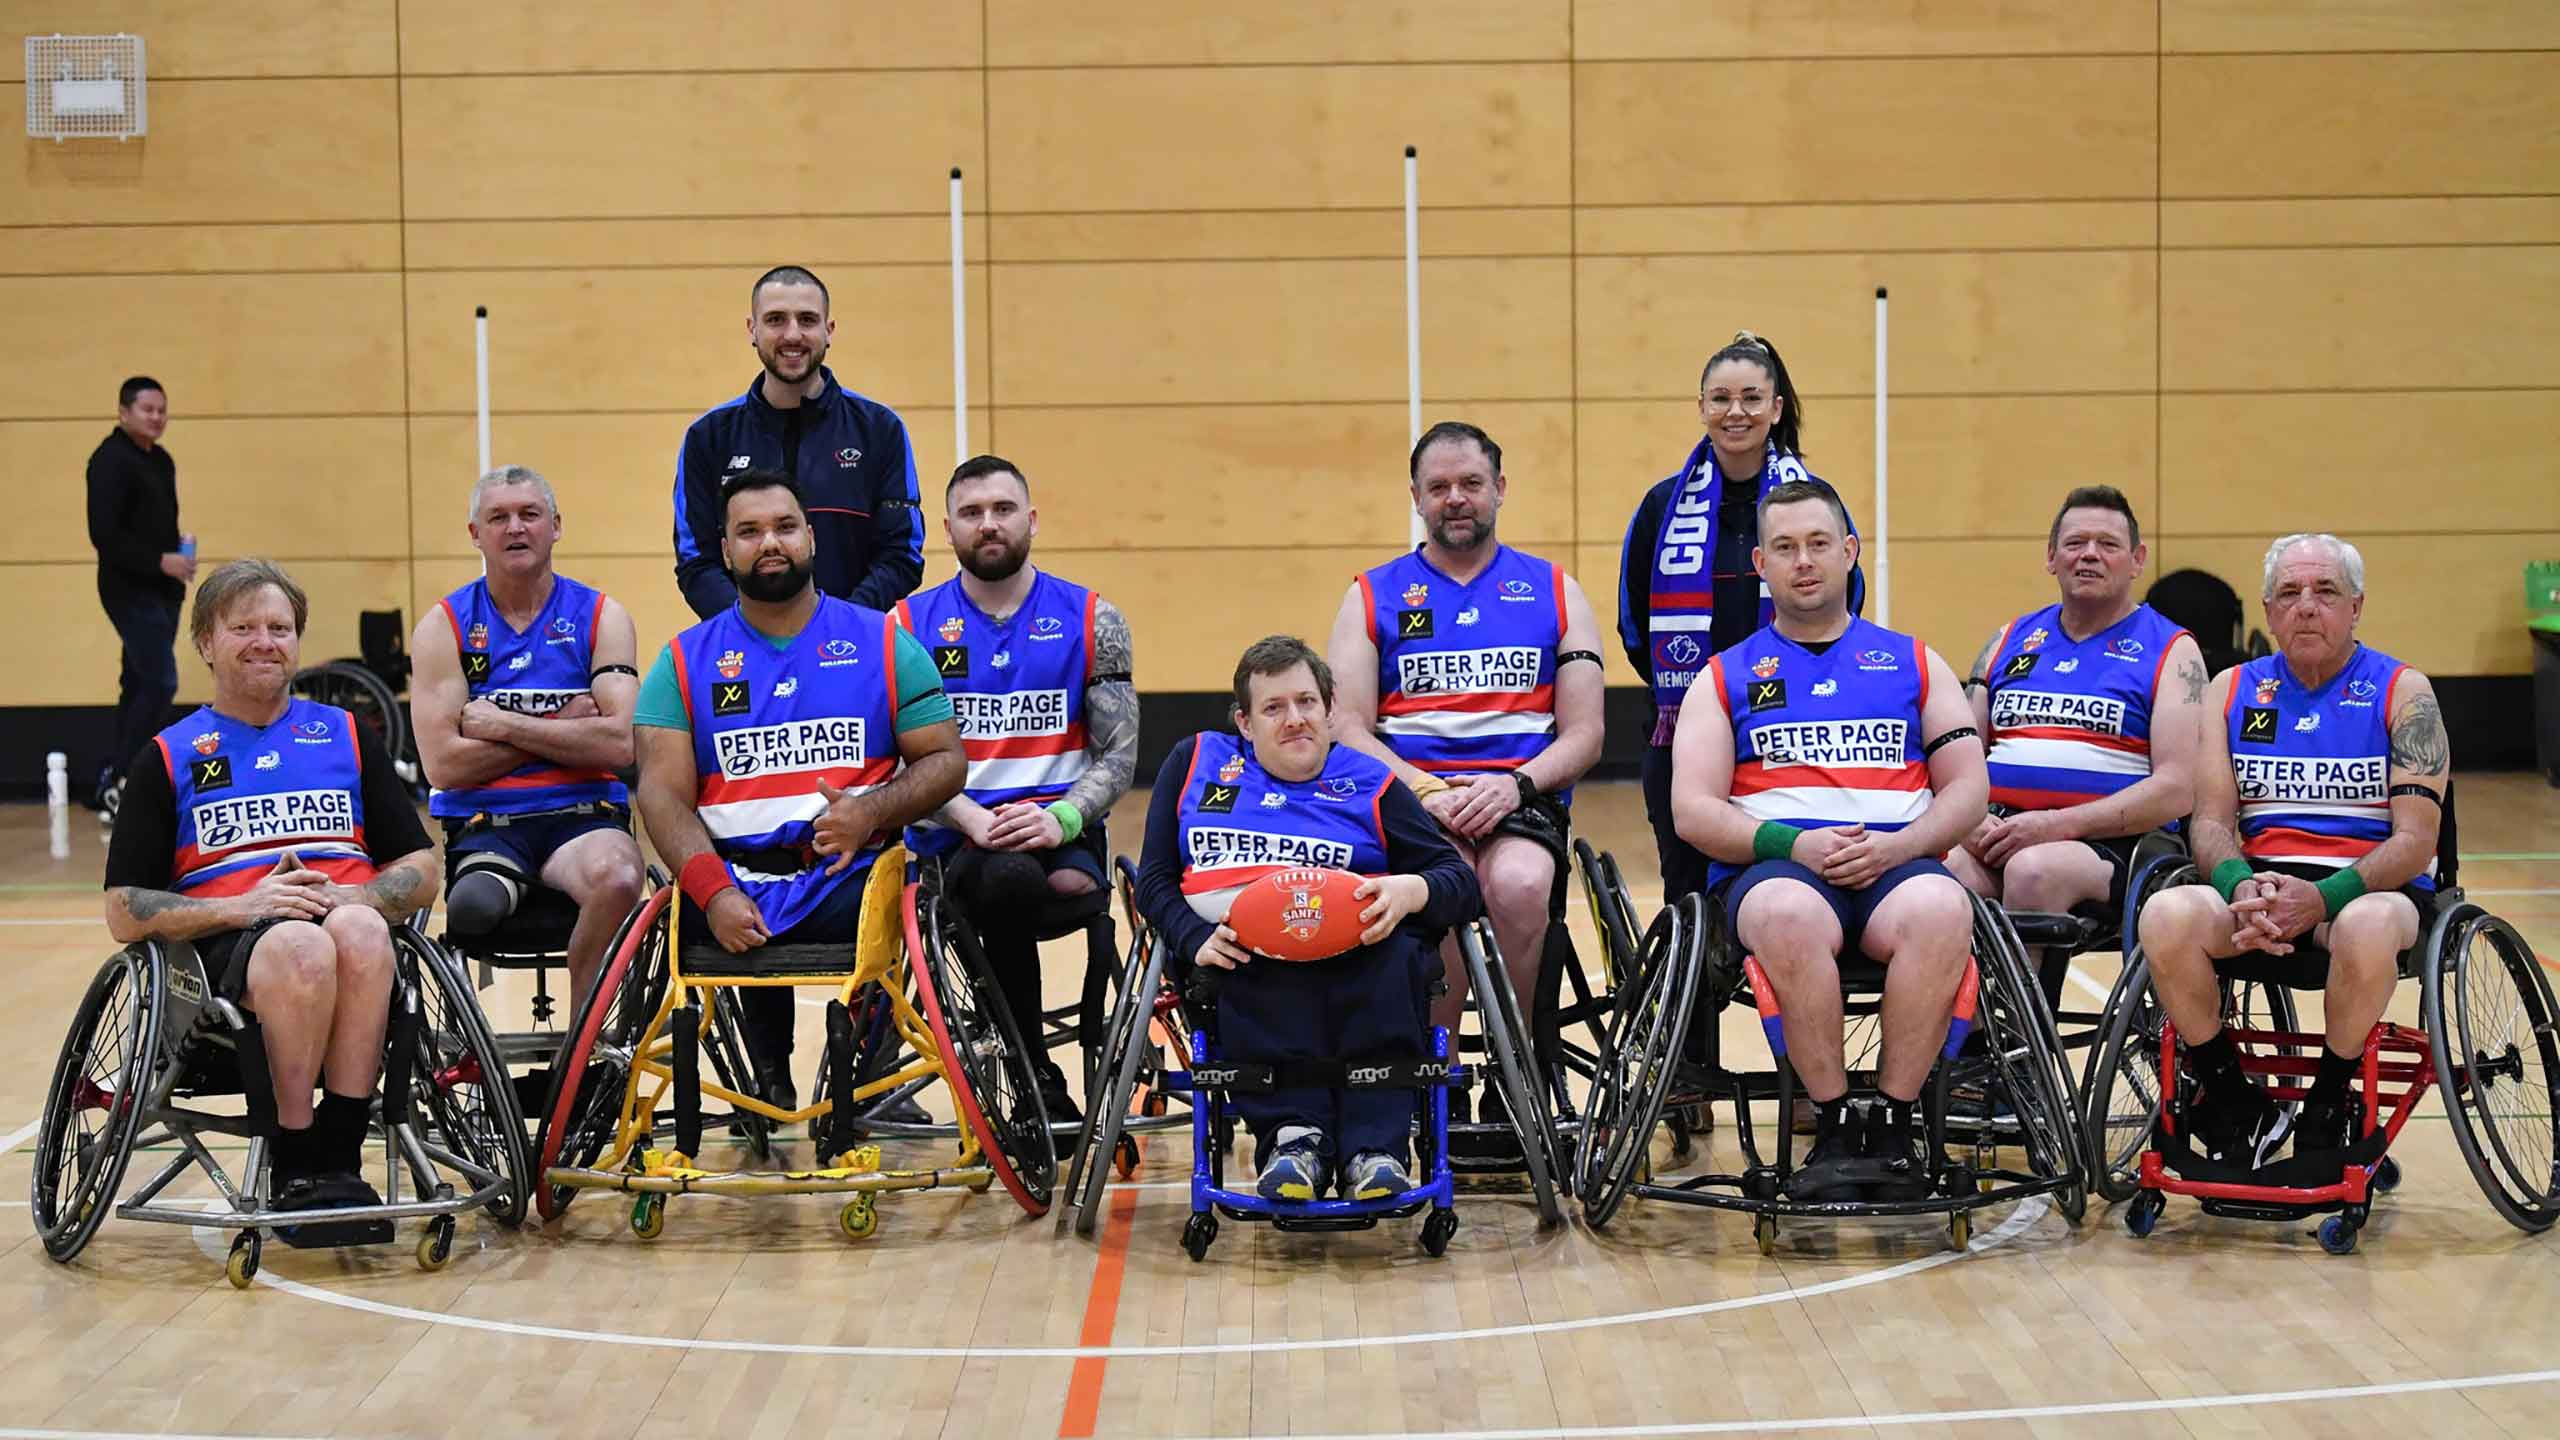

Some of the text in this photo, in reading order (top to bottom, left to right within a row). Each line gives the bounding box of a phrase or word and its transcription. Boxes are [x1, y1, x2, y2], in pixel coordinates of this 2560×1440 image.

[1658, 460, 1713, 576] CDFC
[1404, 651, 1537, 678] PETER PAGE
[1446, 672, 1534, 689] HYUNDAI
[952, 694, 1062, 717] ETER PAGE
[1995, 694, 2120, 722] PETER PAGE
[978, 716, 1062, 734] HYUNDAI
[720, 722, 860, 756] PETER PAGE
[1755, 724, 1904, 752] PETER PAGE
[764, 746, 860, 768] HYUNDAI
[1804, 746, 1901, 763] HYUNDAI
[2234, 758, 2382, 782] PETER PAGE
[2276, 784, 2383, 800] HYUNDAI
[200, 794, 348, 830] PETER PAGE
[250, 816, 350, 838] HYUNDAI
[1192, 831, 1268, 854] PETER
[1279, 838, 1347, 868] PAGE
